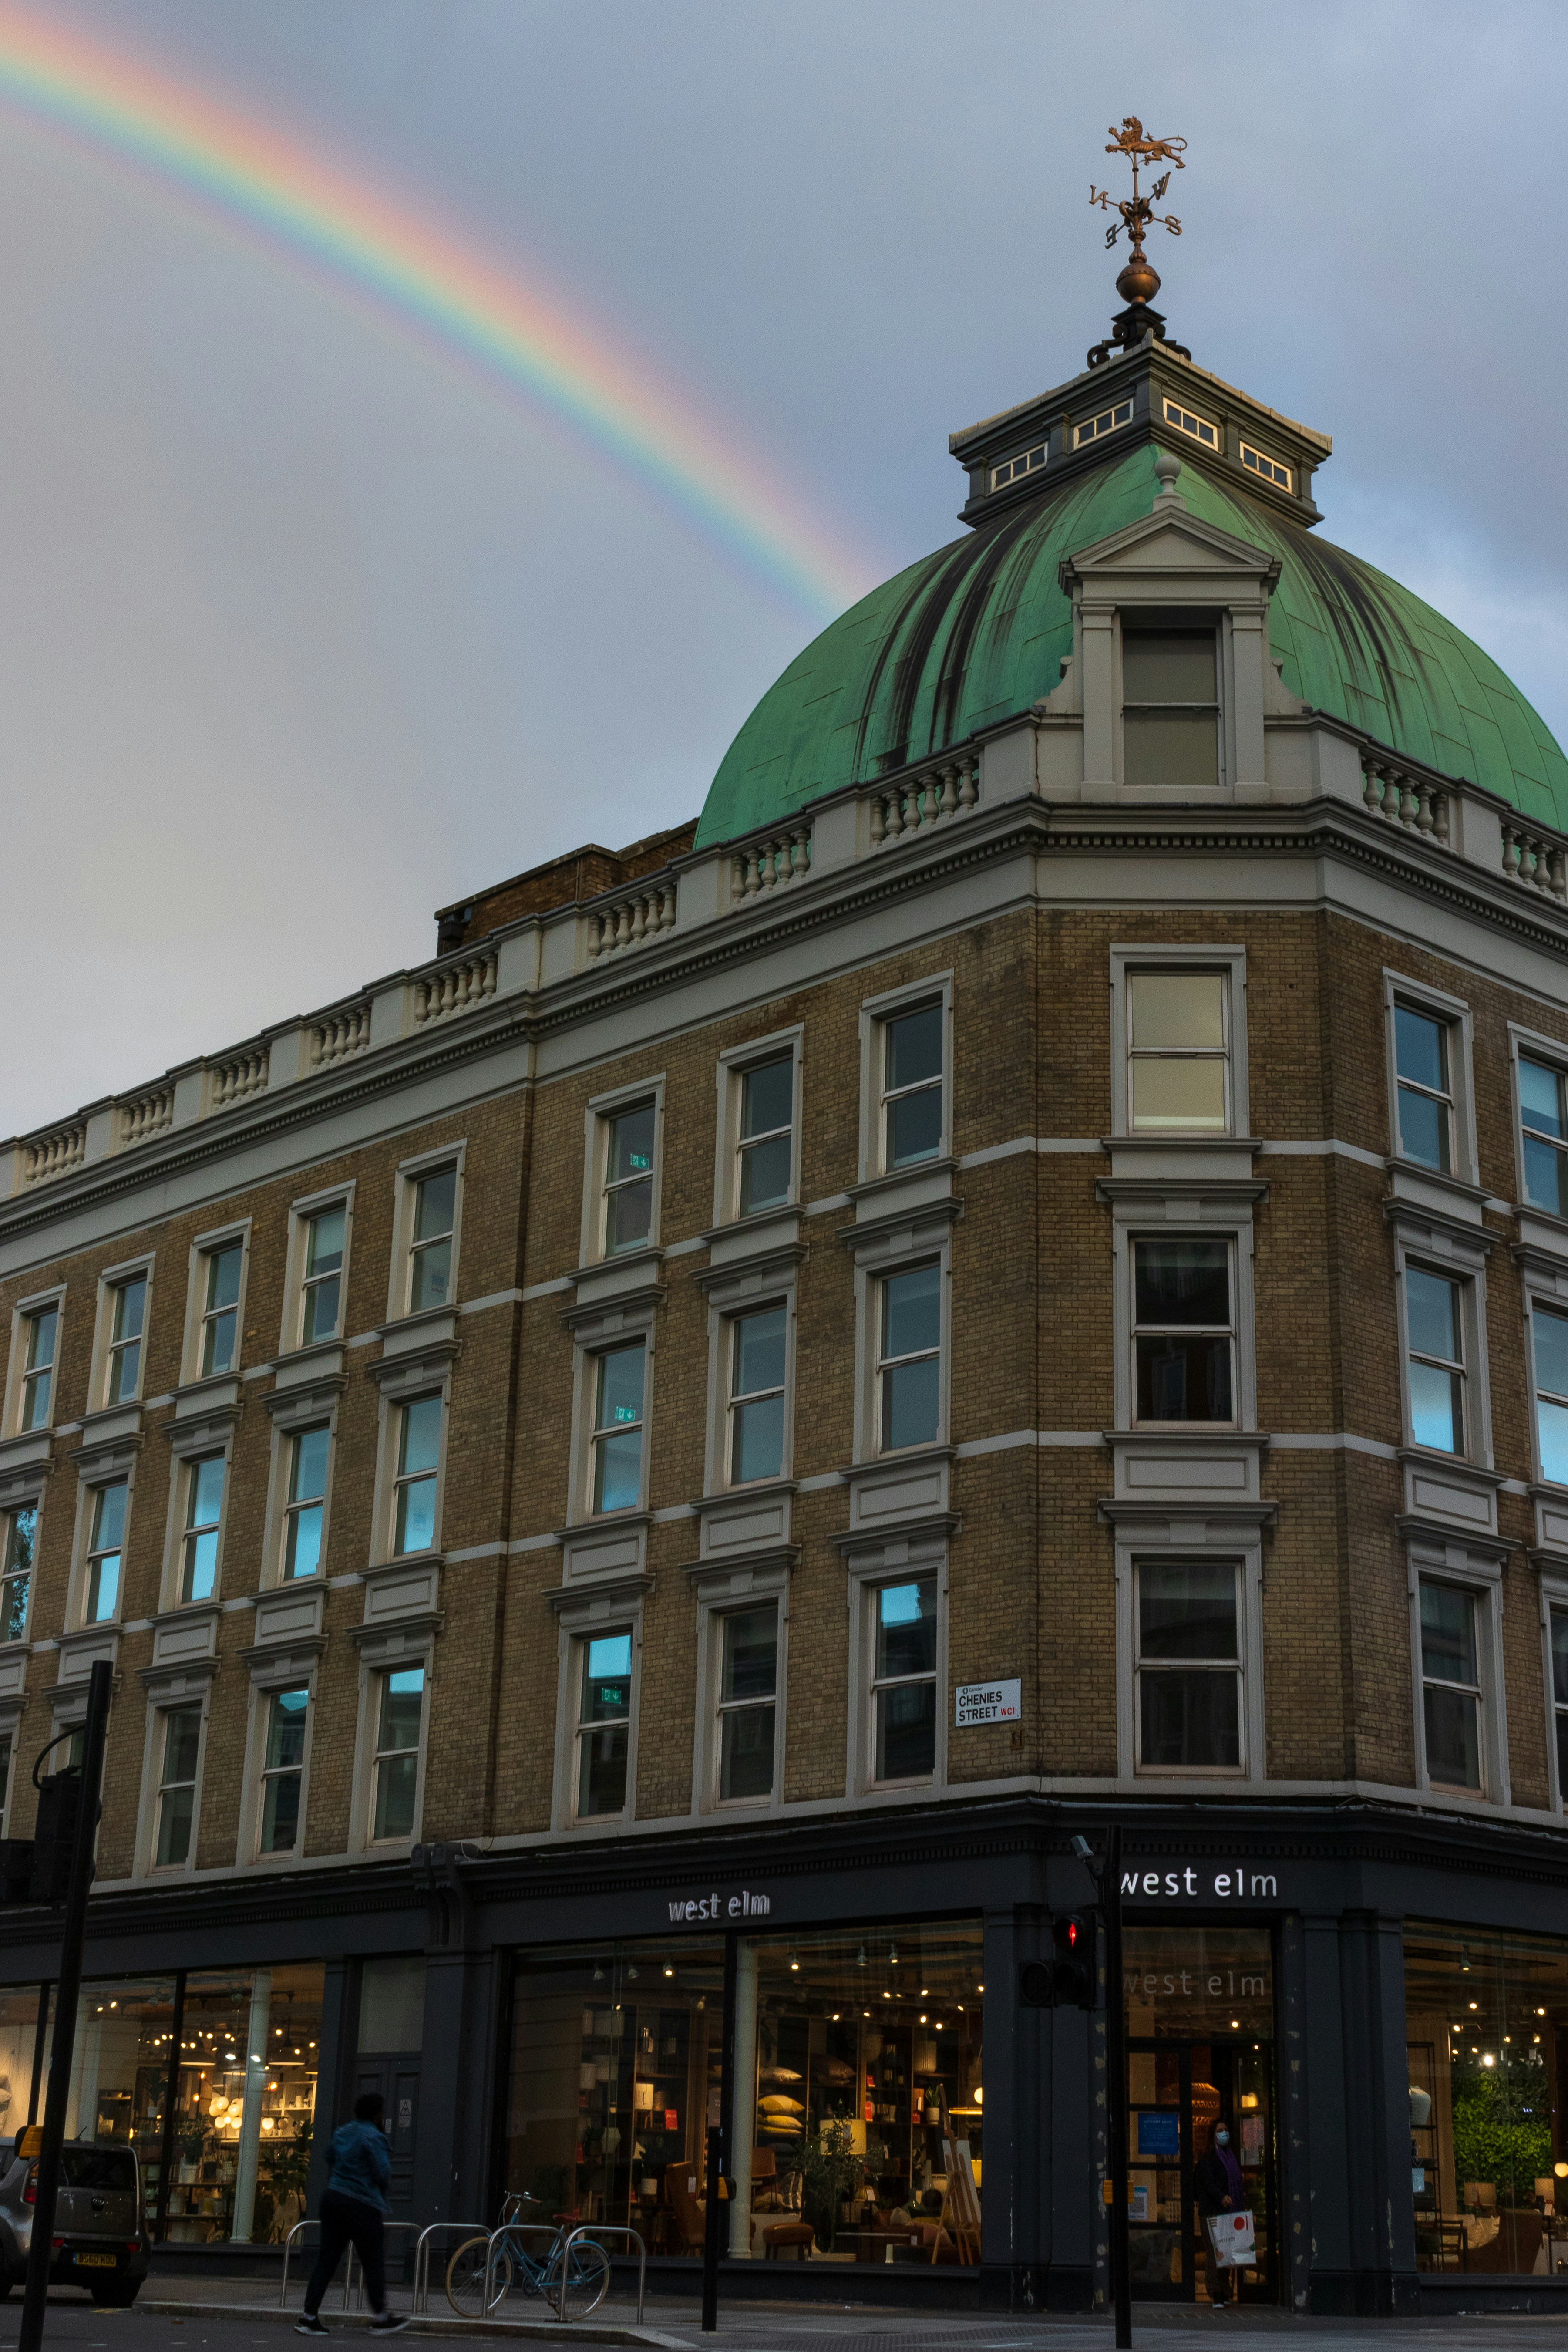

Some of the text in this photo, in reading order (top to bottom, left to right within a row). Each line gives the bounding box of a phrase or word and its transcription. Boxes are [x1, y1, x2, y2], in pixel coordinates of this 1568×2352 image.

[1152, 172, 1171, 200] W
[1165, 215, 1182, 235] S
[959, 1691, 1002, 1707] CHENIES
[959, 1706, 1015, 1721] STREET WC1
[1121, 1867, 1277, 1897] west elm
[669, 1890, 770, 1922] west elm
[1123, 1969, 1264, 1996] west elm
